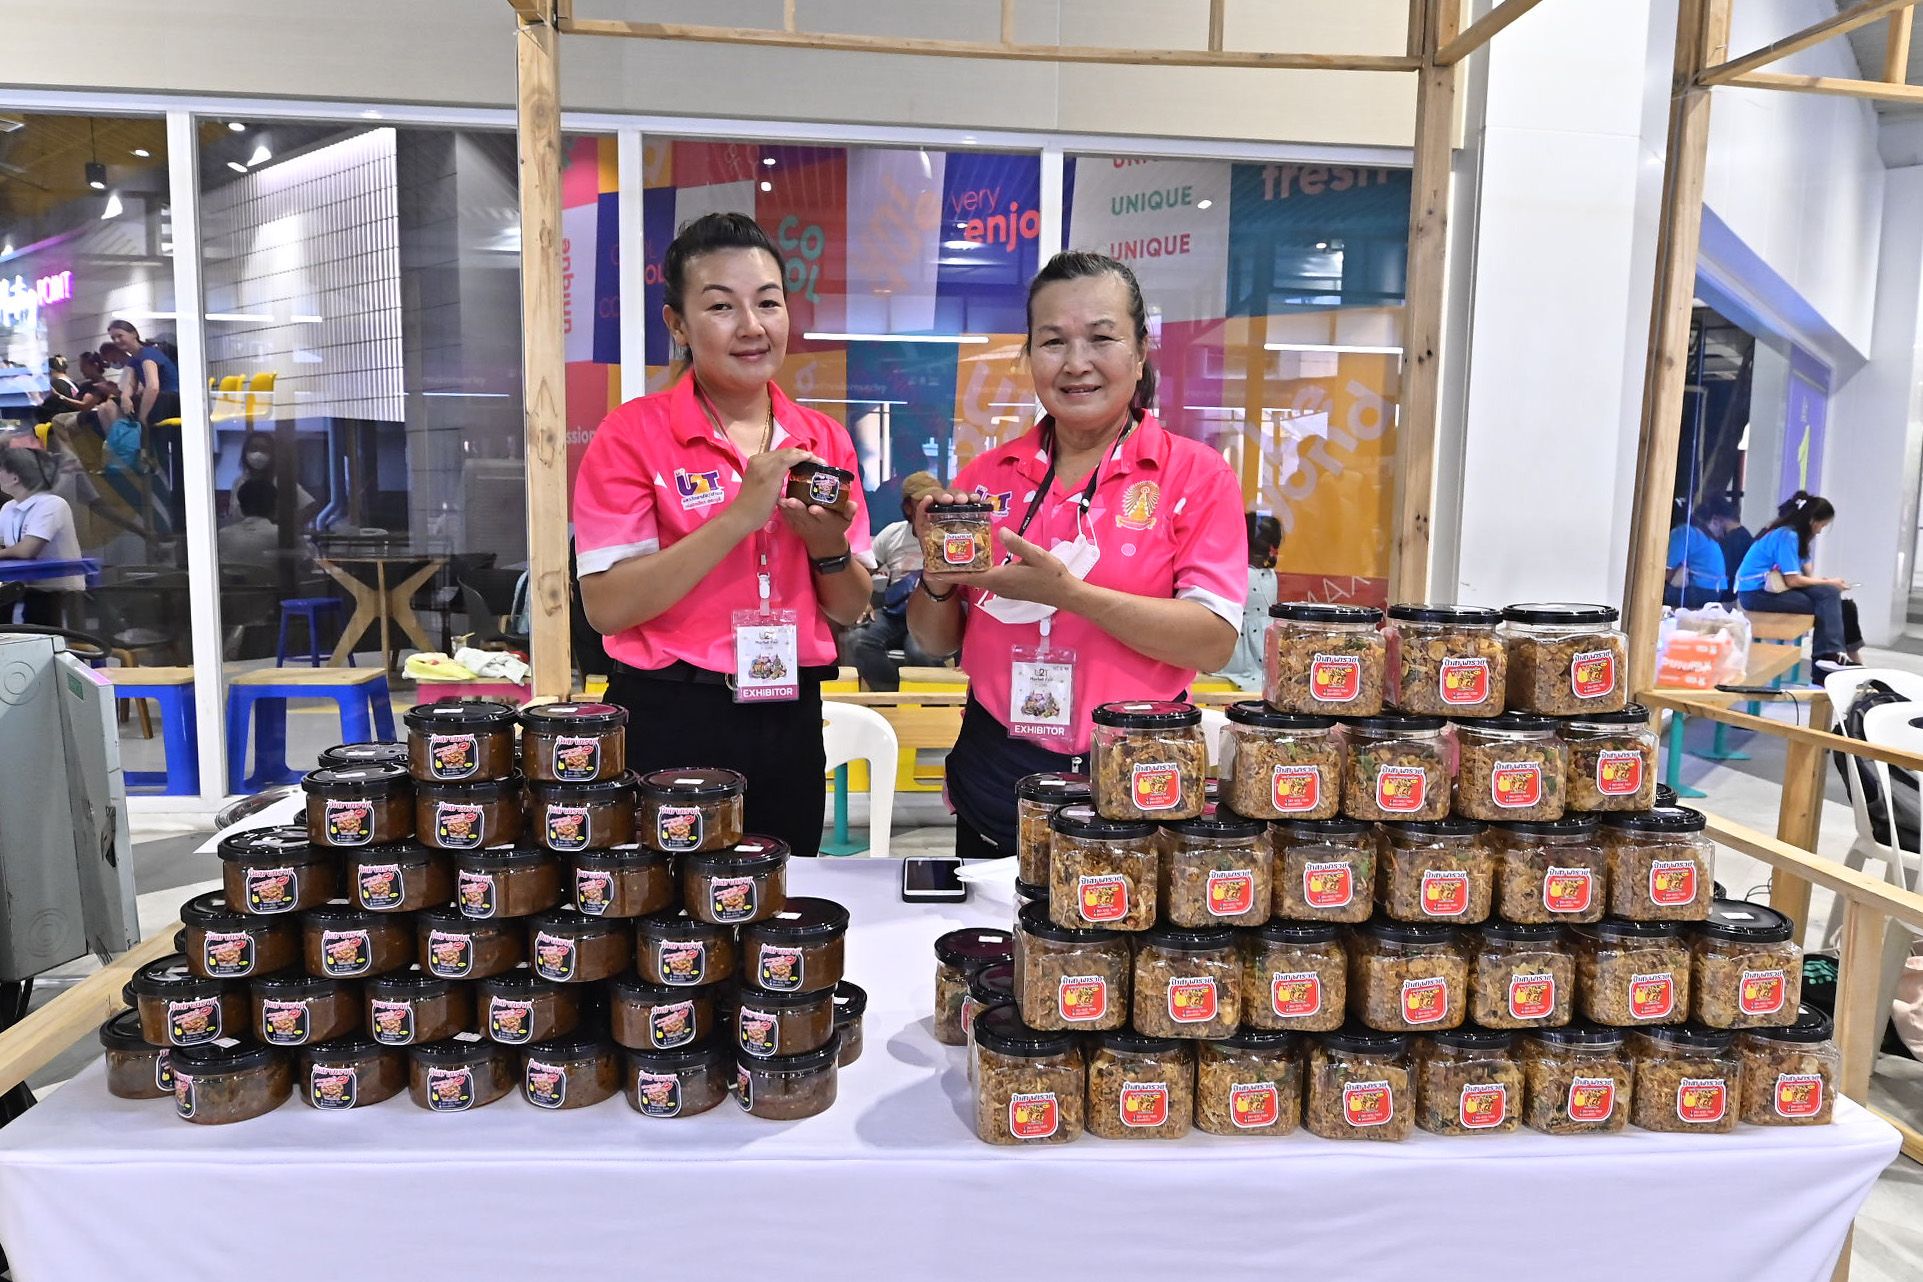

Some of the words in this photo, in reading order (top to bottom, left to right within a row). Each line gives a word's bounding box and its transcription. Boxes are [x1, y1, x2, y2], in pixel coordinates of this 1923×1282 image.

[952, 187, 1000, 214] very
[1111, 186, 1193, 216] UNIQUE
[964, 202, 1040, 252] enjo
[1110, 233, 1191, 262] UNIQUE
[743, 687, 793, 698] EXHIBITOR
[1014, 724, 1065, 736] EXHIBITOR
